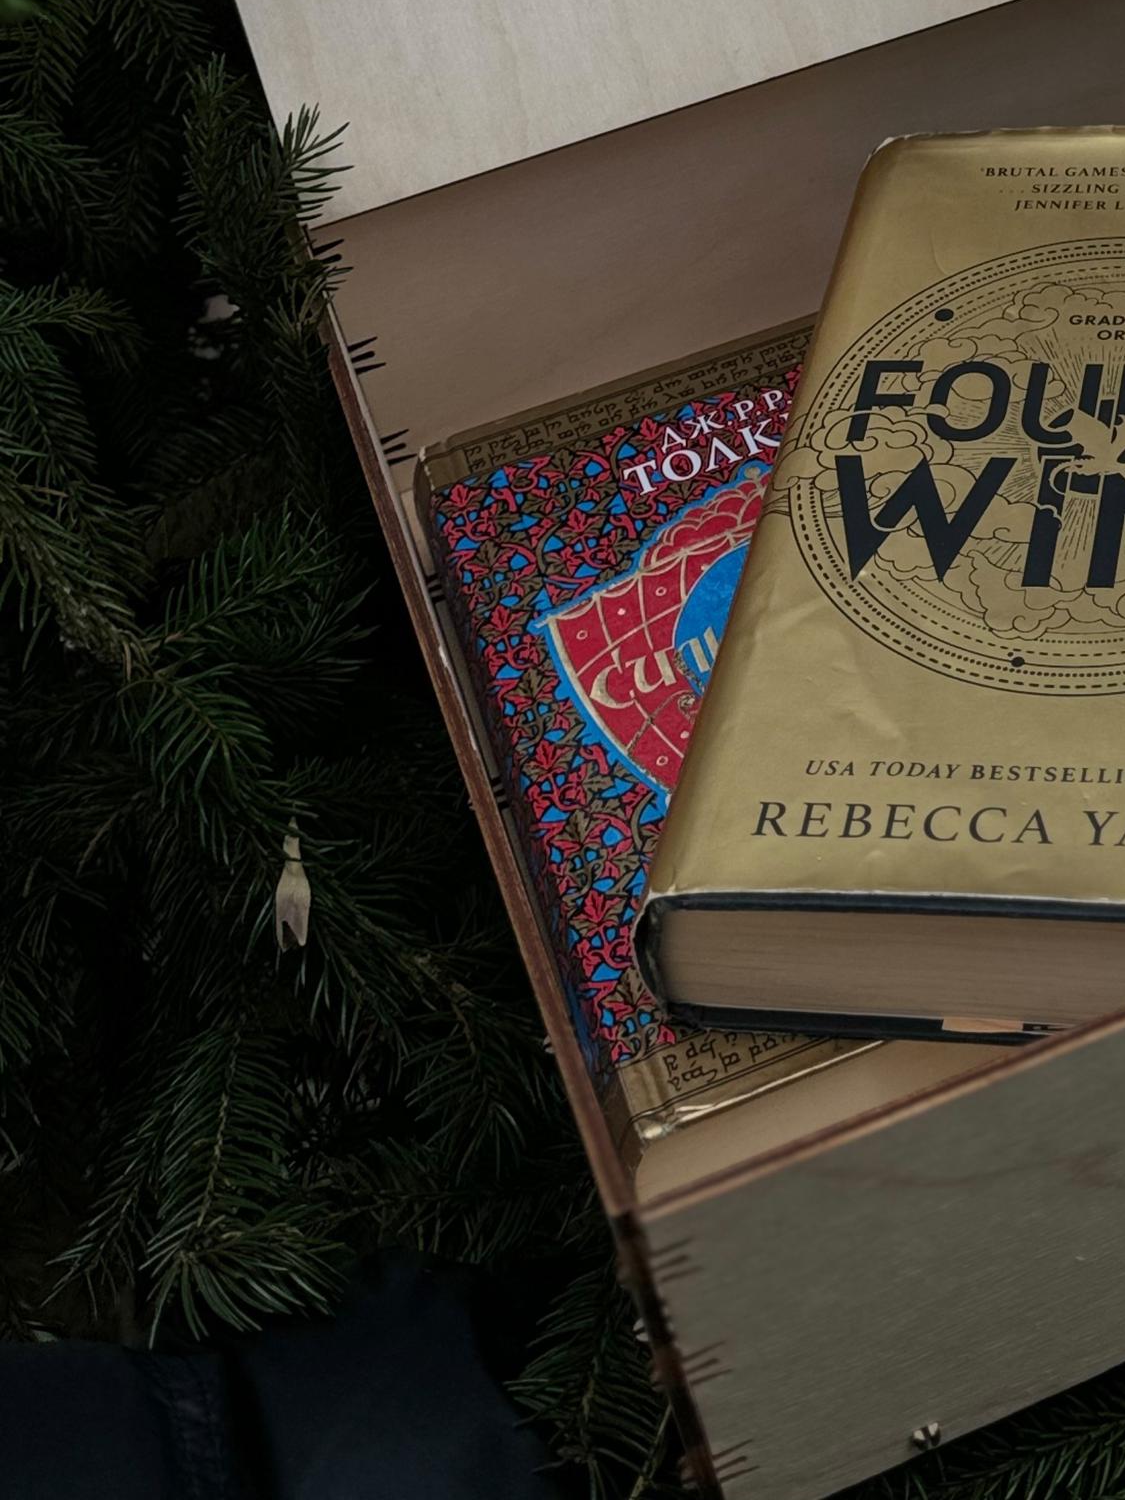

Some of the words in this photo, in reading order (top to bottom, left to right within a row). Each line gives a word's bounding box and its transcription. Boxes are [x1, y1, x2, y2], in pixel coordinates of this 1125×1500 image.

[1031, 184, 1120, 195] SIZZLING
[1014, 200, 1108, 212] JENNIFER
[1096, 329, 1125, 341] OR
[623, 411, 790, 497] ТОЛК
[804, 759, 856, 777] USA
[868, 761, 961, 780] TODAY
[750, 801, 1054, 846] REBECCA
